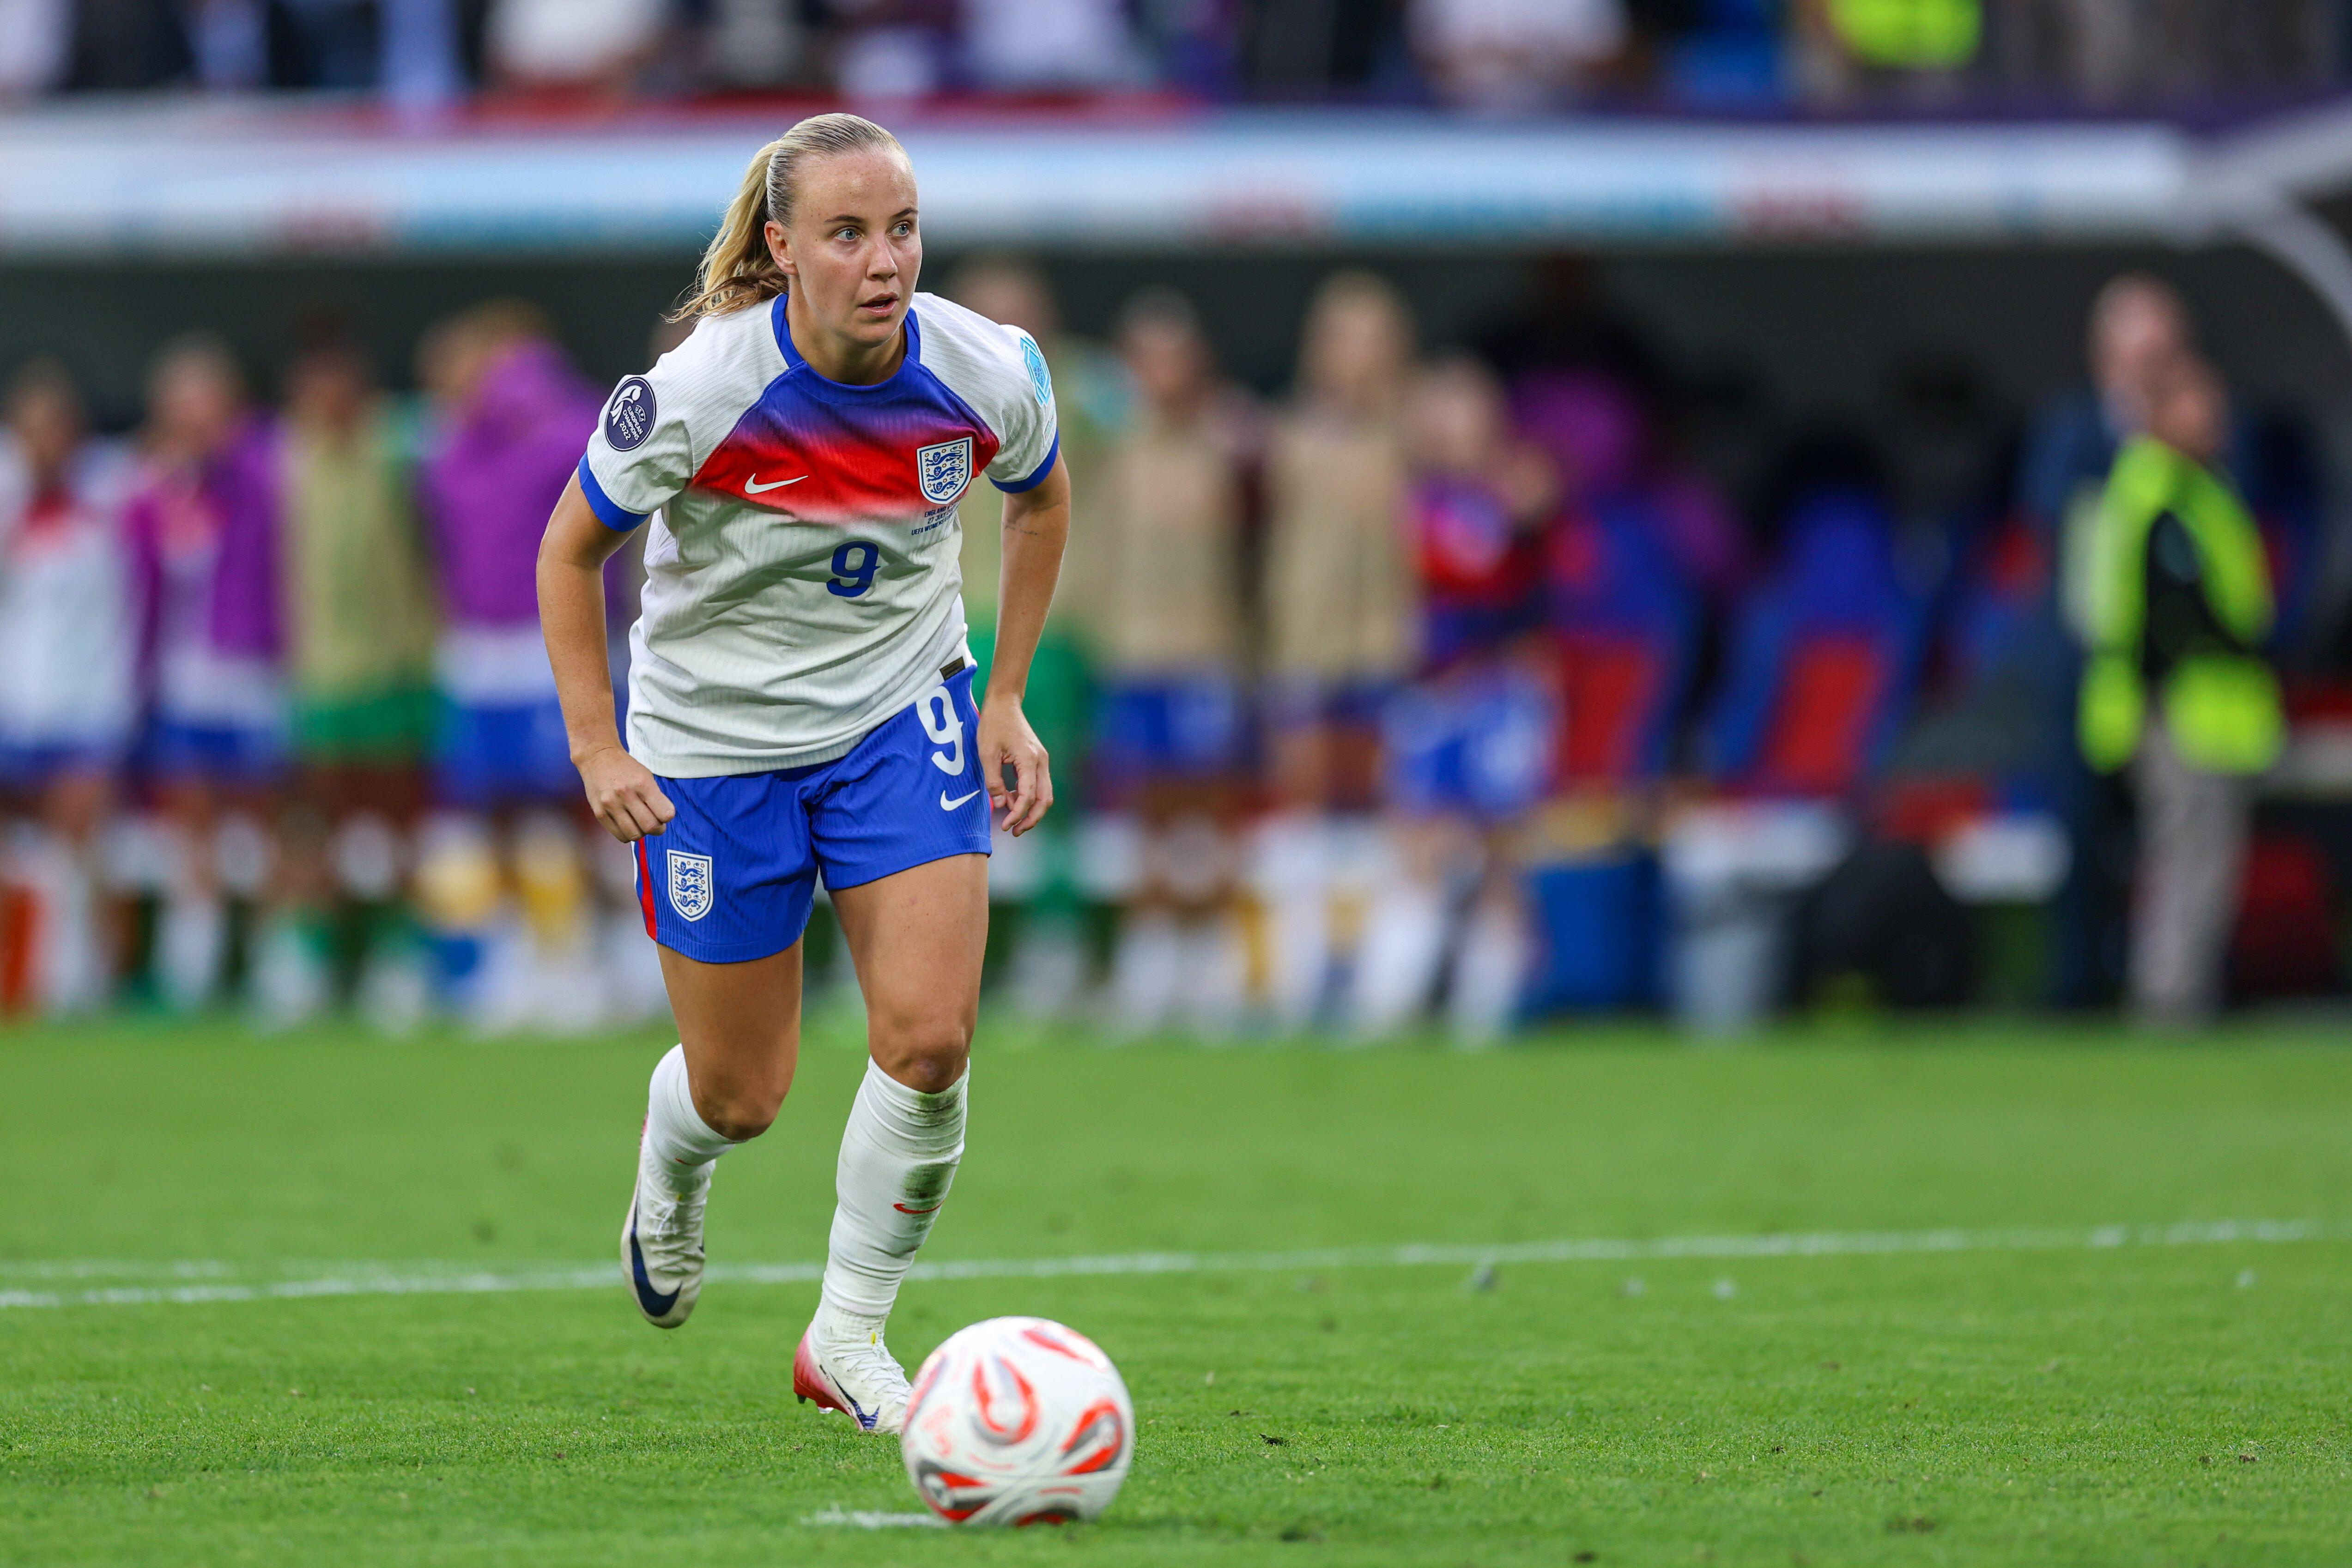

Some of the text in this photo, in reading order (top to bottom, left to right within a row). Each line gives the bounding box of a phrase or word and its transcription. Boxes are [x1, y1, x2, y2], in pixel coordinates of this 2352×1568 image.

[623, 410, 640, 441] CHAMPIONS
[627, 406, 643, 435] EUROPEAN
[635, 406, 644, 422] UEFA
[619, 421, 631, 441] 2022
[924, 506, 946, 517] ENGLAND
[826, 541, 881, 597] 9
[916, 685, 965, 776] 9
